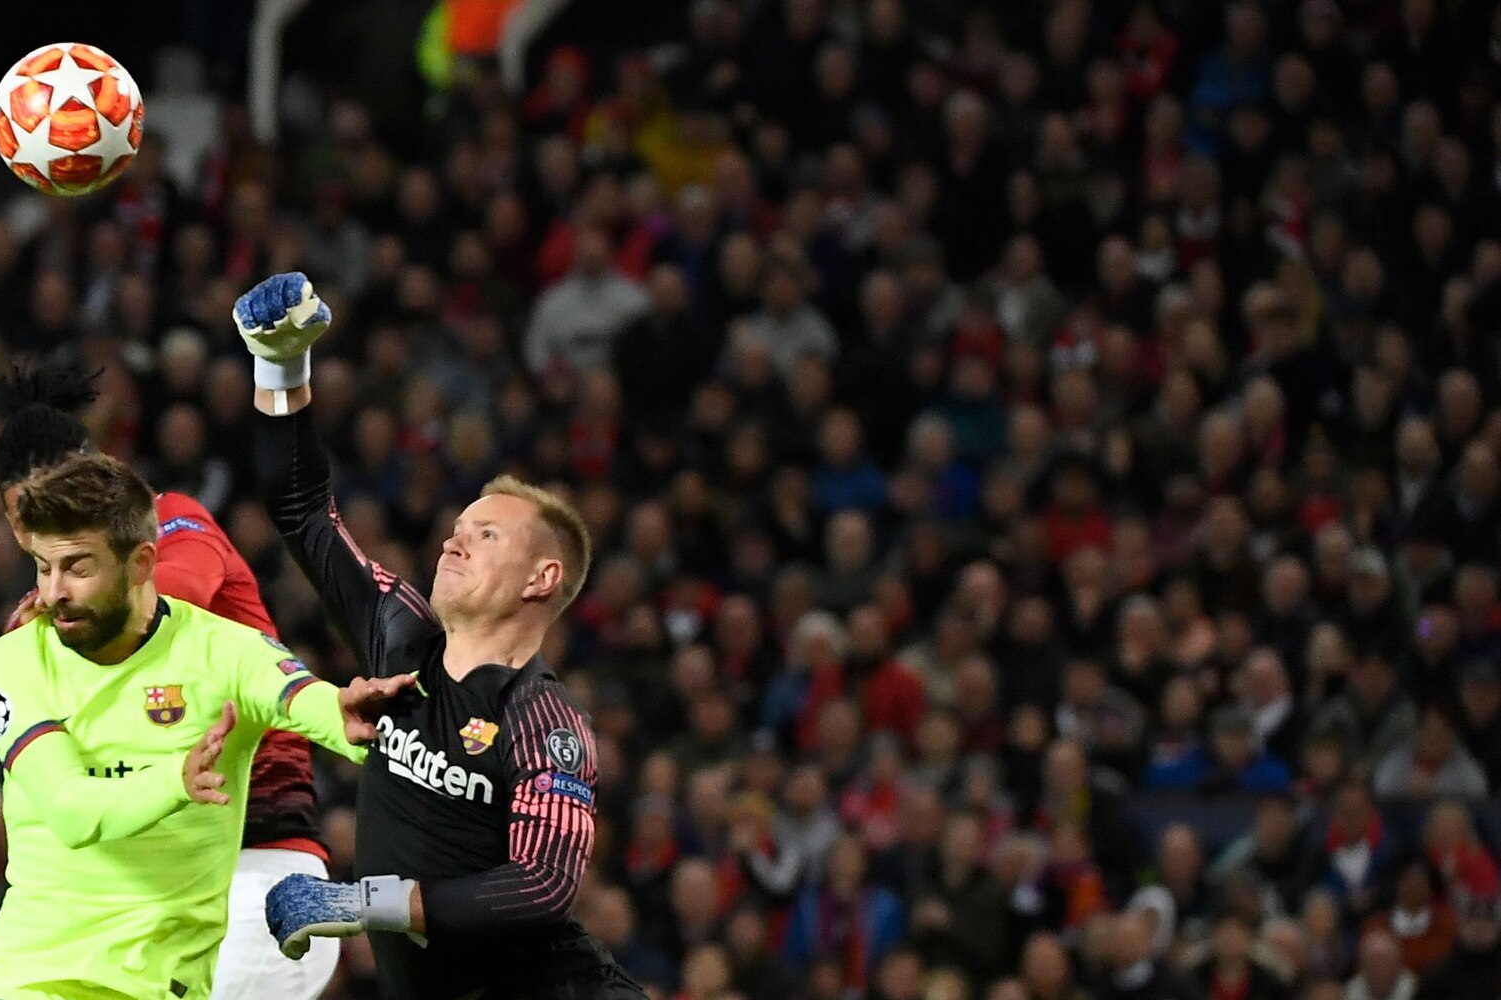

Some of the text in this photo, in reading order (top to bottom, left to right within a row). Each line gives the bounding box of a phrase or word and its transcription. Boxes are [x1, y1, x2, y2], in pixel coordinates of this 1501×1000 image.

[375, 714, 494, 805] Rakuten
[562, 748, 573, 762] 5
[552, 778, 592, 800] RESPECT
